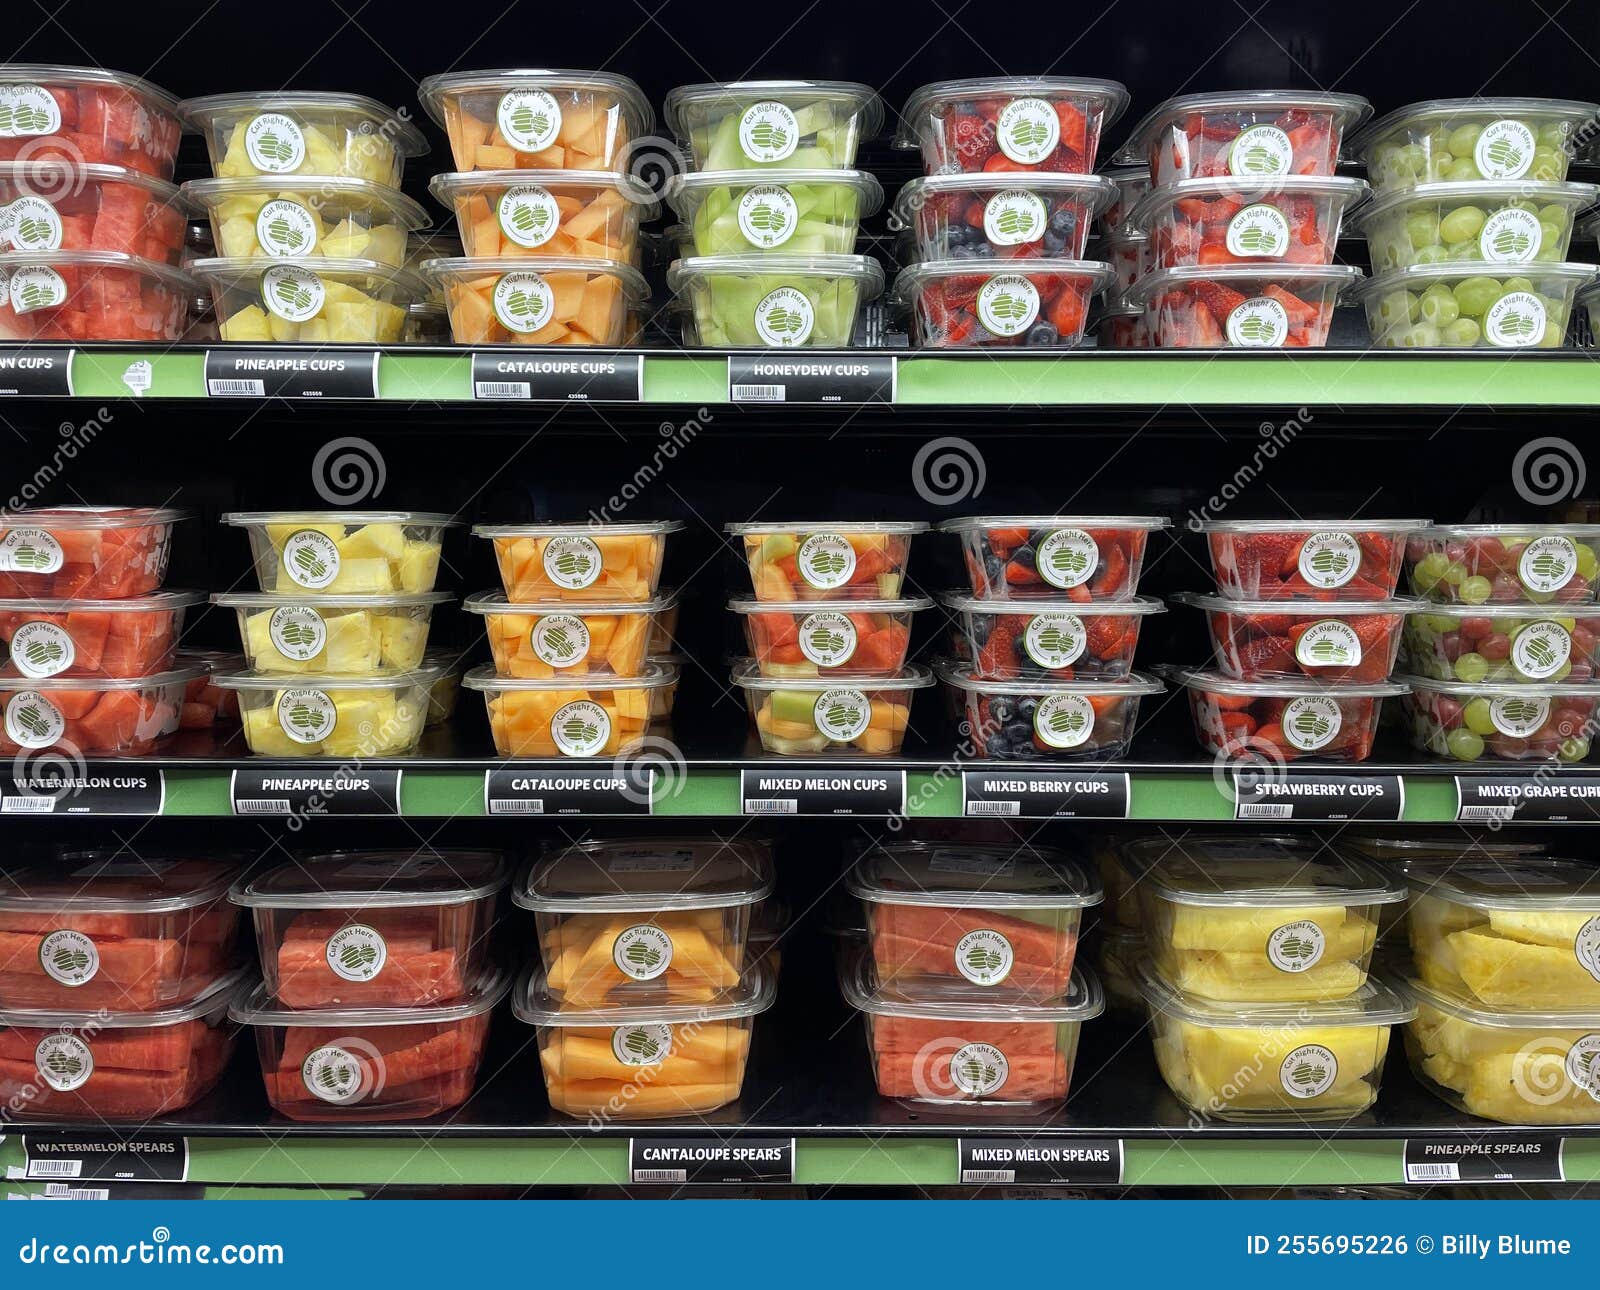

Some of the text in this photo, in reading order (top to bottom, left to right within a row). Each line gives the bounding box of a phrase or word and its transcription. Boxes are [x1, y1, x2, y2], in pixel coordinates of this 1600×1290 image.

[745, 104, 793, 125] Cut Right Here
[251, 117, 299, 139] Cut Right Here
[1487, 123, 1531, 149] Cut Right Here
[502, 187, 547, 215] Cut Right Here
[743, 187, 791, 207] Cut Right Here
[989, 190, 1037, 215] Cut Right Here
[264, 202, 310, 228] Cut Right Here
[497, 274, 544, 298] Cut Right Here
[984, 276, 1032, 298] Cut Right Here
[759, 290, 806, 313] Cut Right Here
[1234, 300, 1282, 319] Cut Right Here
[18, 358, 53, 369] CUPS
[235, 359, 345, 371] PINEAPPLE CUPS
[498, 362, 616, 374] CATALOUPE CUPS
[754, 364, 869, 376] HONEYDEW CUPS
[7, 529, 56, 549] Cut Right Here
[294, 534, 307, 544] Cut
[309, 533, 328, 546] Right
[802, 534, 848, 557] Cut Right Here
[1045, 530, 1093, 551] Cut Right Here
[1304, 532, 1355, 553] Cut Right Here
[1528, 538, 1573, 557] Cut Right Here
[273, 607, 317, 627] Cut Right Here
[548, 616, 561, 624] Cut
[562, 616, 581, 630] Right
[804, 612, 850, 632] Cut Right Here
[14, 624, 59, 652] Cut Right Here
[1305, 624, 1354, 643] Cut Right Here
[1531, 626, 1544, 634] Cut
[1546, 625, 1565, 639] Right
[557, 704, 604, 722] Cut Right Here
[1291, 696, 1337, 716] Cut Right Here
[13, 778, 147, 789] WATERMELON CUPS
[262, 779, 370, 791] PINEAPPLE CUPS
[512, 779, 627, 790] CATALOUPE CUPS
[759, 779, 887, 791] MIXED MELON CUPS
[984, 781, 1109, 793] MIXED BERRY CUPS
[1255, 784, 1384, 796] STRAWBERRY CUPS
[1478, 786, 1521, 797] MIXED
[1524, 786, 1568, 797] GRAPE
[621, 928, 668, 948] Cut Right Here
[1274, 922, 1320, 941] Cut Right Here
[43, 931, 88, 956] Cut Right Here
[329, 928, 373, 957] Cut Right Here
[960, 932, 1006, 951] Cut Right Here
[1285, 1048, 1330, 1069] Cut Right Here
[36, 1143, 175, 1153] WATERMELON SPEARS
[643, 1148, 781, 1160] CANTALOUPE SPEARS
[972, 1149, 1110, 1161] MIXED MELON SPEARS
[1424, 1144, 1541, 1155] PINEAPPLE SPEARS
